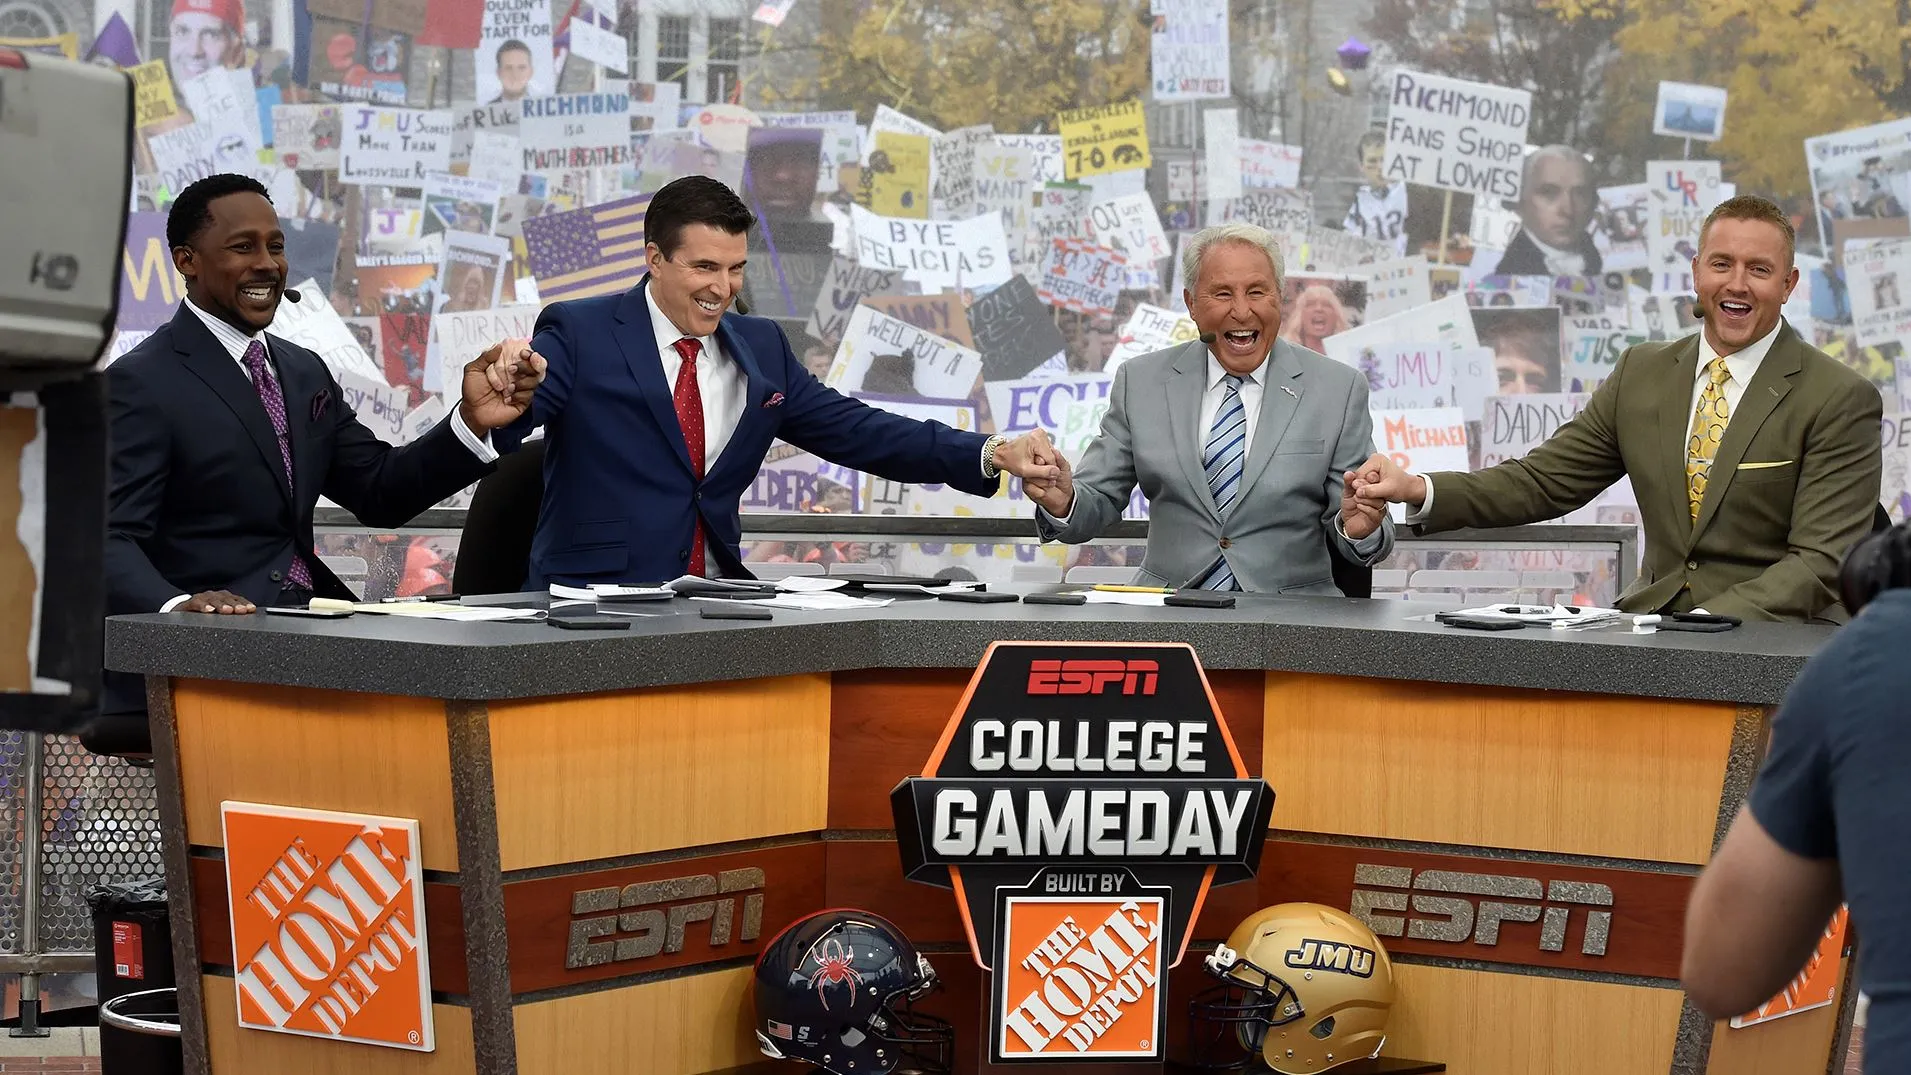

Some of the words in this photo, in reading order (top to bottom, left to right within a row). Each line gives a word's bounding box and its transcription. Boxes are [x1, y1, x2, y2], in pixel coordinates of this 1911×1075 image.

[484, 26, 519, 39] TART
[523, 24, 550, 37] FOR
[494, 12, 530, 24] EVEN
[355, 109, 409, 132] JMU
[523, 94, 628, 117] RICHMOND
[1393, 74, 1526, 128] RICHMOND
[401, 135, 437, 152] THAN
[1390, 118, 1445, 150] FANS
[1457, 127, 1521, 163] SHOP
[976, 180, 1027, 200] WANT
[1388, 154, 1422, 180] AT
[1436, 158, 1519, 198] LOWES
[889, 221, 955, 246] BYE
[1092, 202, 1120, 231] OJ
[858, 236, 995, 273] FELICIAS
[1142, 308, 1174, 332] THE
[908, 334, 946, 366] PUT
[944, 352, 964, 376] A
[1388, 350, 1441, 389] JMU
[1027, 660, 1159, 695] ESPN
[970, 719, 1208, 773] COLLEGE
[932, 788, 1253, 857] GAMEDAY
[246, 835, 321, 921] THE
[1045, 873, 1097, 893] BUILT
[1100, 873, 1126, 892] BY
[238, 825, 412, 1028] HOME
[565, 866, 766, 970] ESPN
[1349, 862, 1614, 956] ESPN
[1022, 916, 1088, 979] THE
[1284, 938, 1376, 978] JMU
[308, 906, 418, 1036] DEPOT
[1005, 900, 1159, 1054] HOME
[1062, 955, 1158, 1054] DEPOT
